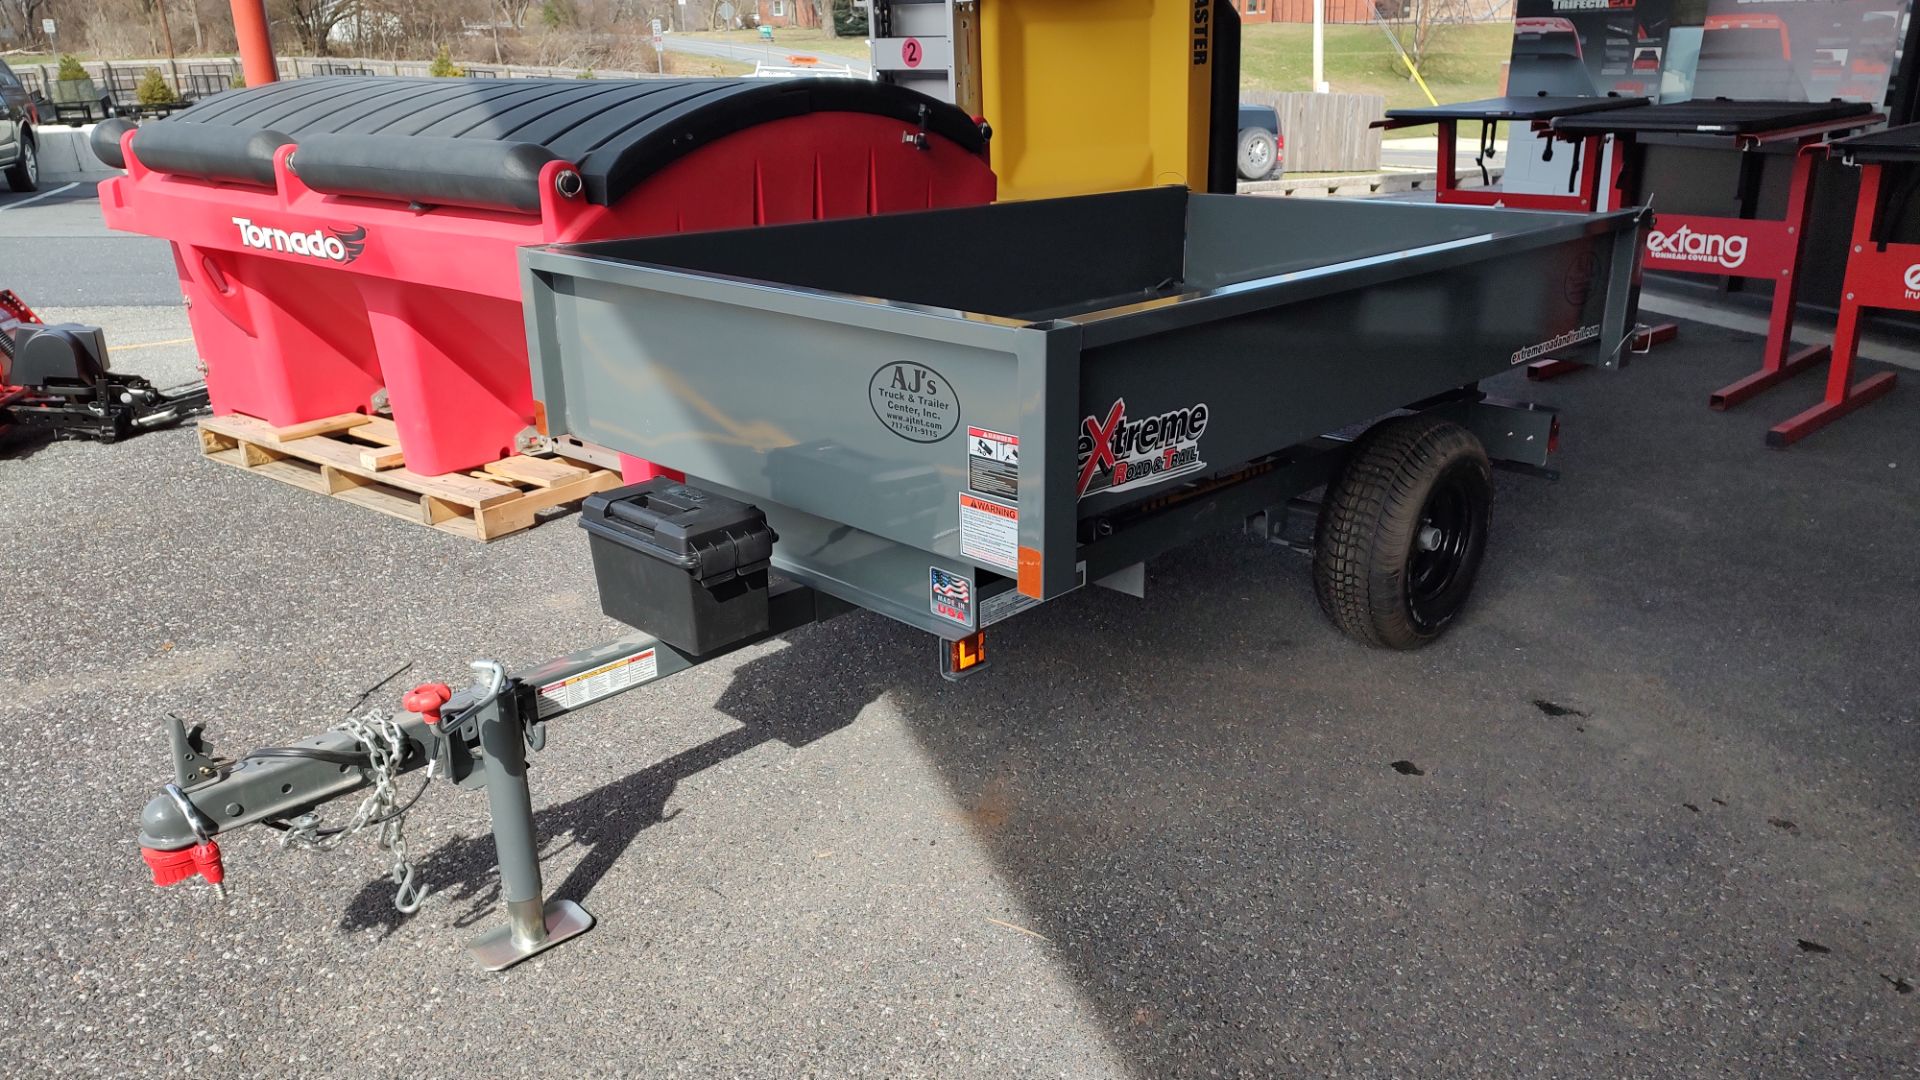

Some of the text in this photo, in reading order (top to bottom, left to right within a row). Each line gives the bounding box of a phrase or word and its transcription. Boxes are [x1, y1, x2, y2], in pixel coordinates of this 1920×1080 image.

[907, 42, 917, 62] 2
[231, 216, 347, 262] Tornado
[1647, 224, 1748, 268] extang
[1651, 251, 1719, 263] TONNEAU COVERS
[891, 366, 937, 395] AJ's
[879, 388, 949, 410] Truck & Trailer
[887, 401, 941, 420] Center, Inc.
[1152, 456, 1163, 475] &
[976, 501, 1016, 519] WARNING
[937, 595, 966, 610] MADE IN
[937, 603, 965, 621] USA
